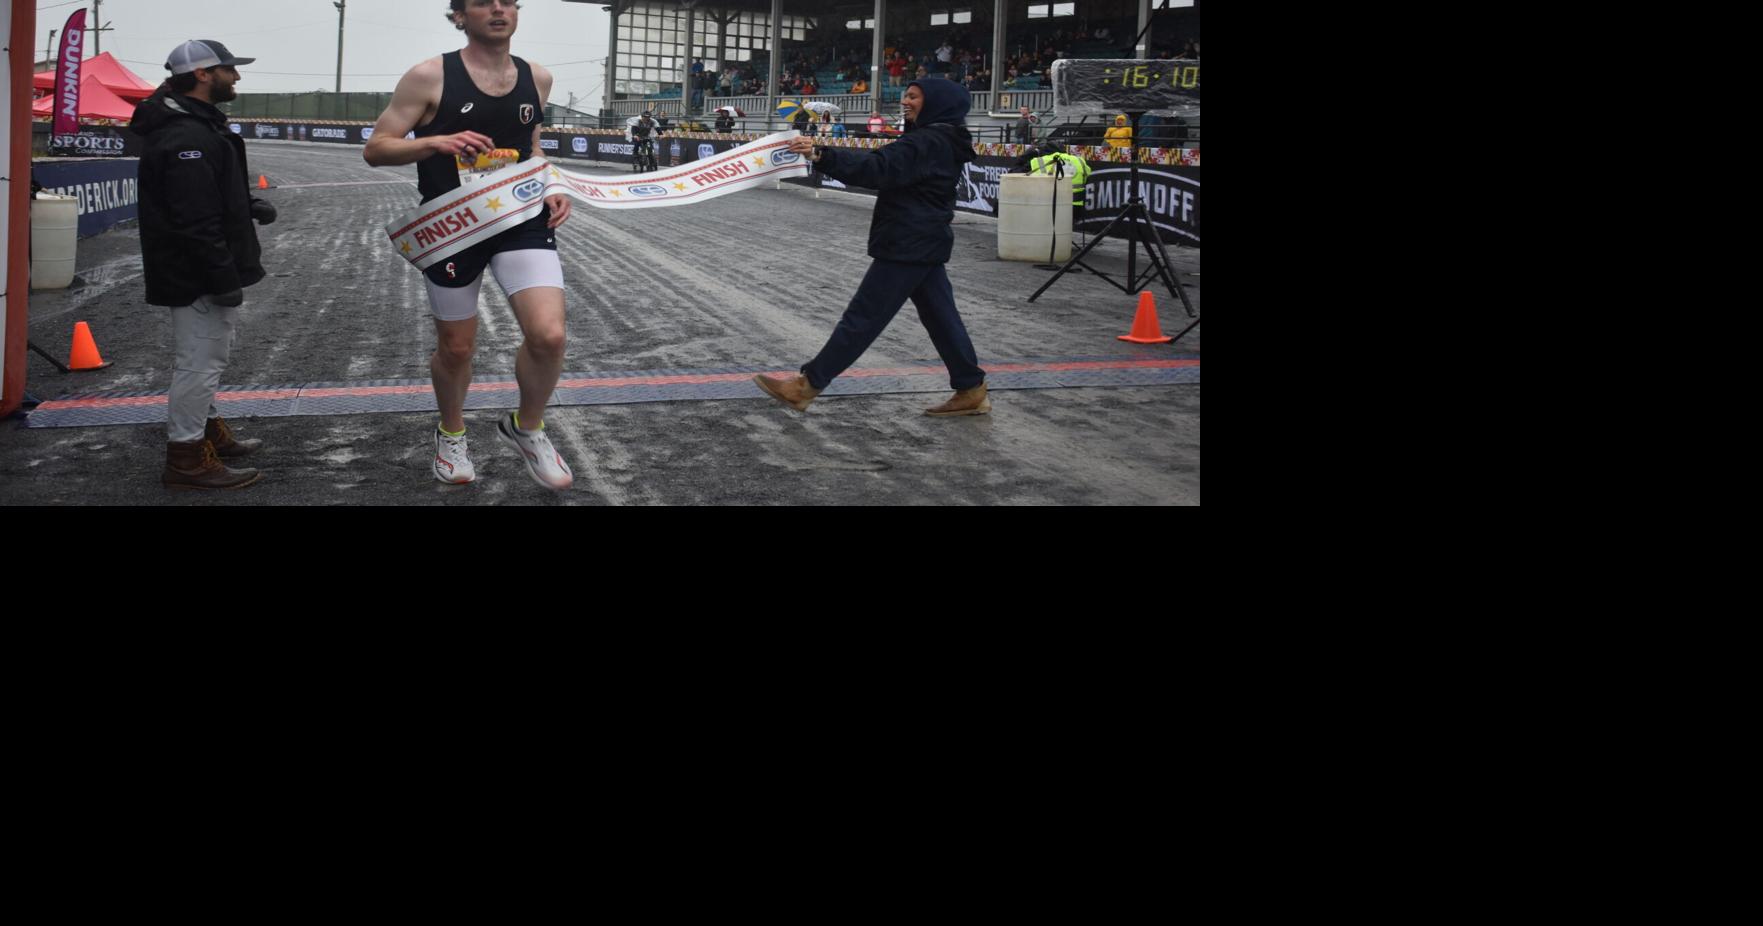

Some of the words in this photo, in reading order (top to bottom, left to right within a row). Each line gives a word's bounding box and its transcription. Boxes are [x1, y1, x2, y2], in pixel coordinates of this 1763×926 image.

[63, 28, 81, 121] DUNKIN'
[53, 135, 124, 149] SPORTS
[312, 128, 347, 138] GATORADE
[598, 142, 624, 154] RUNNER'S
[47, 178, 138, 215] DERICK.OR
[413, 206, 479, 248] FINISH
[691, 160, 749, 186] FINISH
